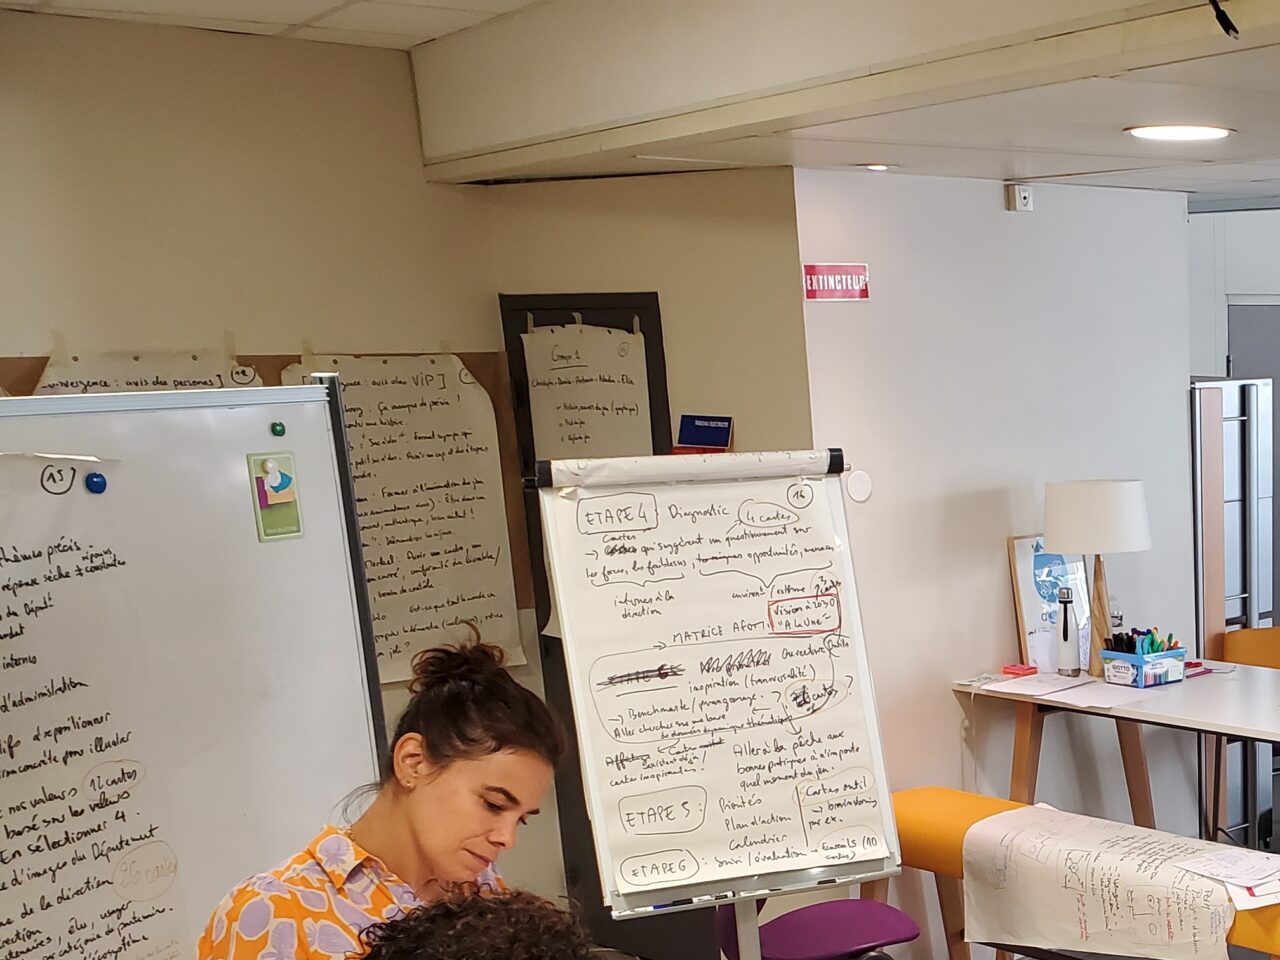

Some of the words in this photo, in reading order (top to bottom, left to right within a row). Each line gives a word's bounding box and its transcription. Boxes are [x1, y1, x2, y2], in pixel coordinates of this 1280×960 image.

[806, 274, 866, 291] EXTINCTEUR
[46, 465, 65, 485] 15
[585, 505, 635, 526] ETAPE
[638, 501, 648, 524] 4
[667, 503, 731, 524] Diagnostic
[759, 512, 791, 524] cartes
[621, 604, 663, 619] direction
[773, 603, 803, 616] Vision
[813, 597, 836, 610] 2030
[672, 620, 724, 645] MATRICE
[1111, 664, 1131, 672] GIOTTO
[733, 740, 762, 757] Aller
[792, 731, 823, 757] pêche
[740, 773, 762, 792] quel
[763, 769, 798, 786] moment
[805, 782, 839, 797] Cartes
[842, 775, 867, 791] outil
[718, 793, 762, 813] Priorités
[625, 805, 676, 828] ETAPE
[681, 800, 691, 818] 5
[724, 816, 750, 832] Plan
[728, 833, 788, 851] Calendrier
[631, 860, 678, 878] ETAPE
[56, 875, 115, 905] direction
